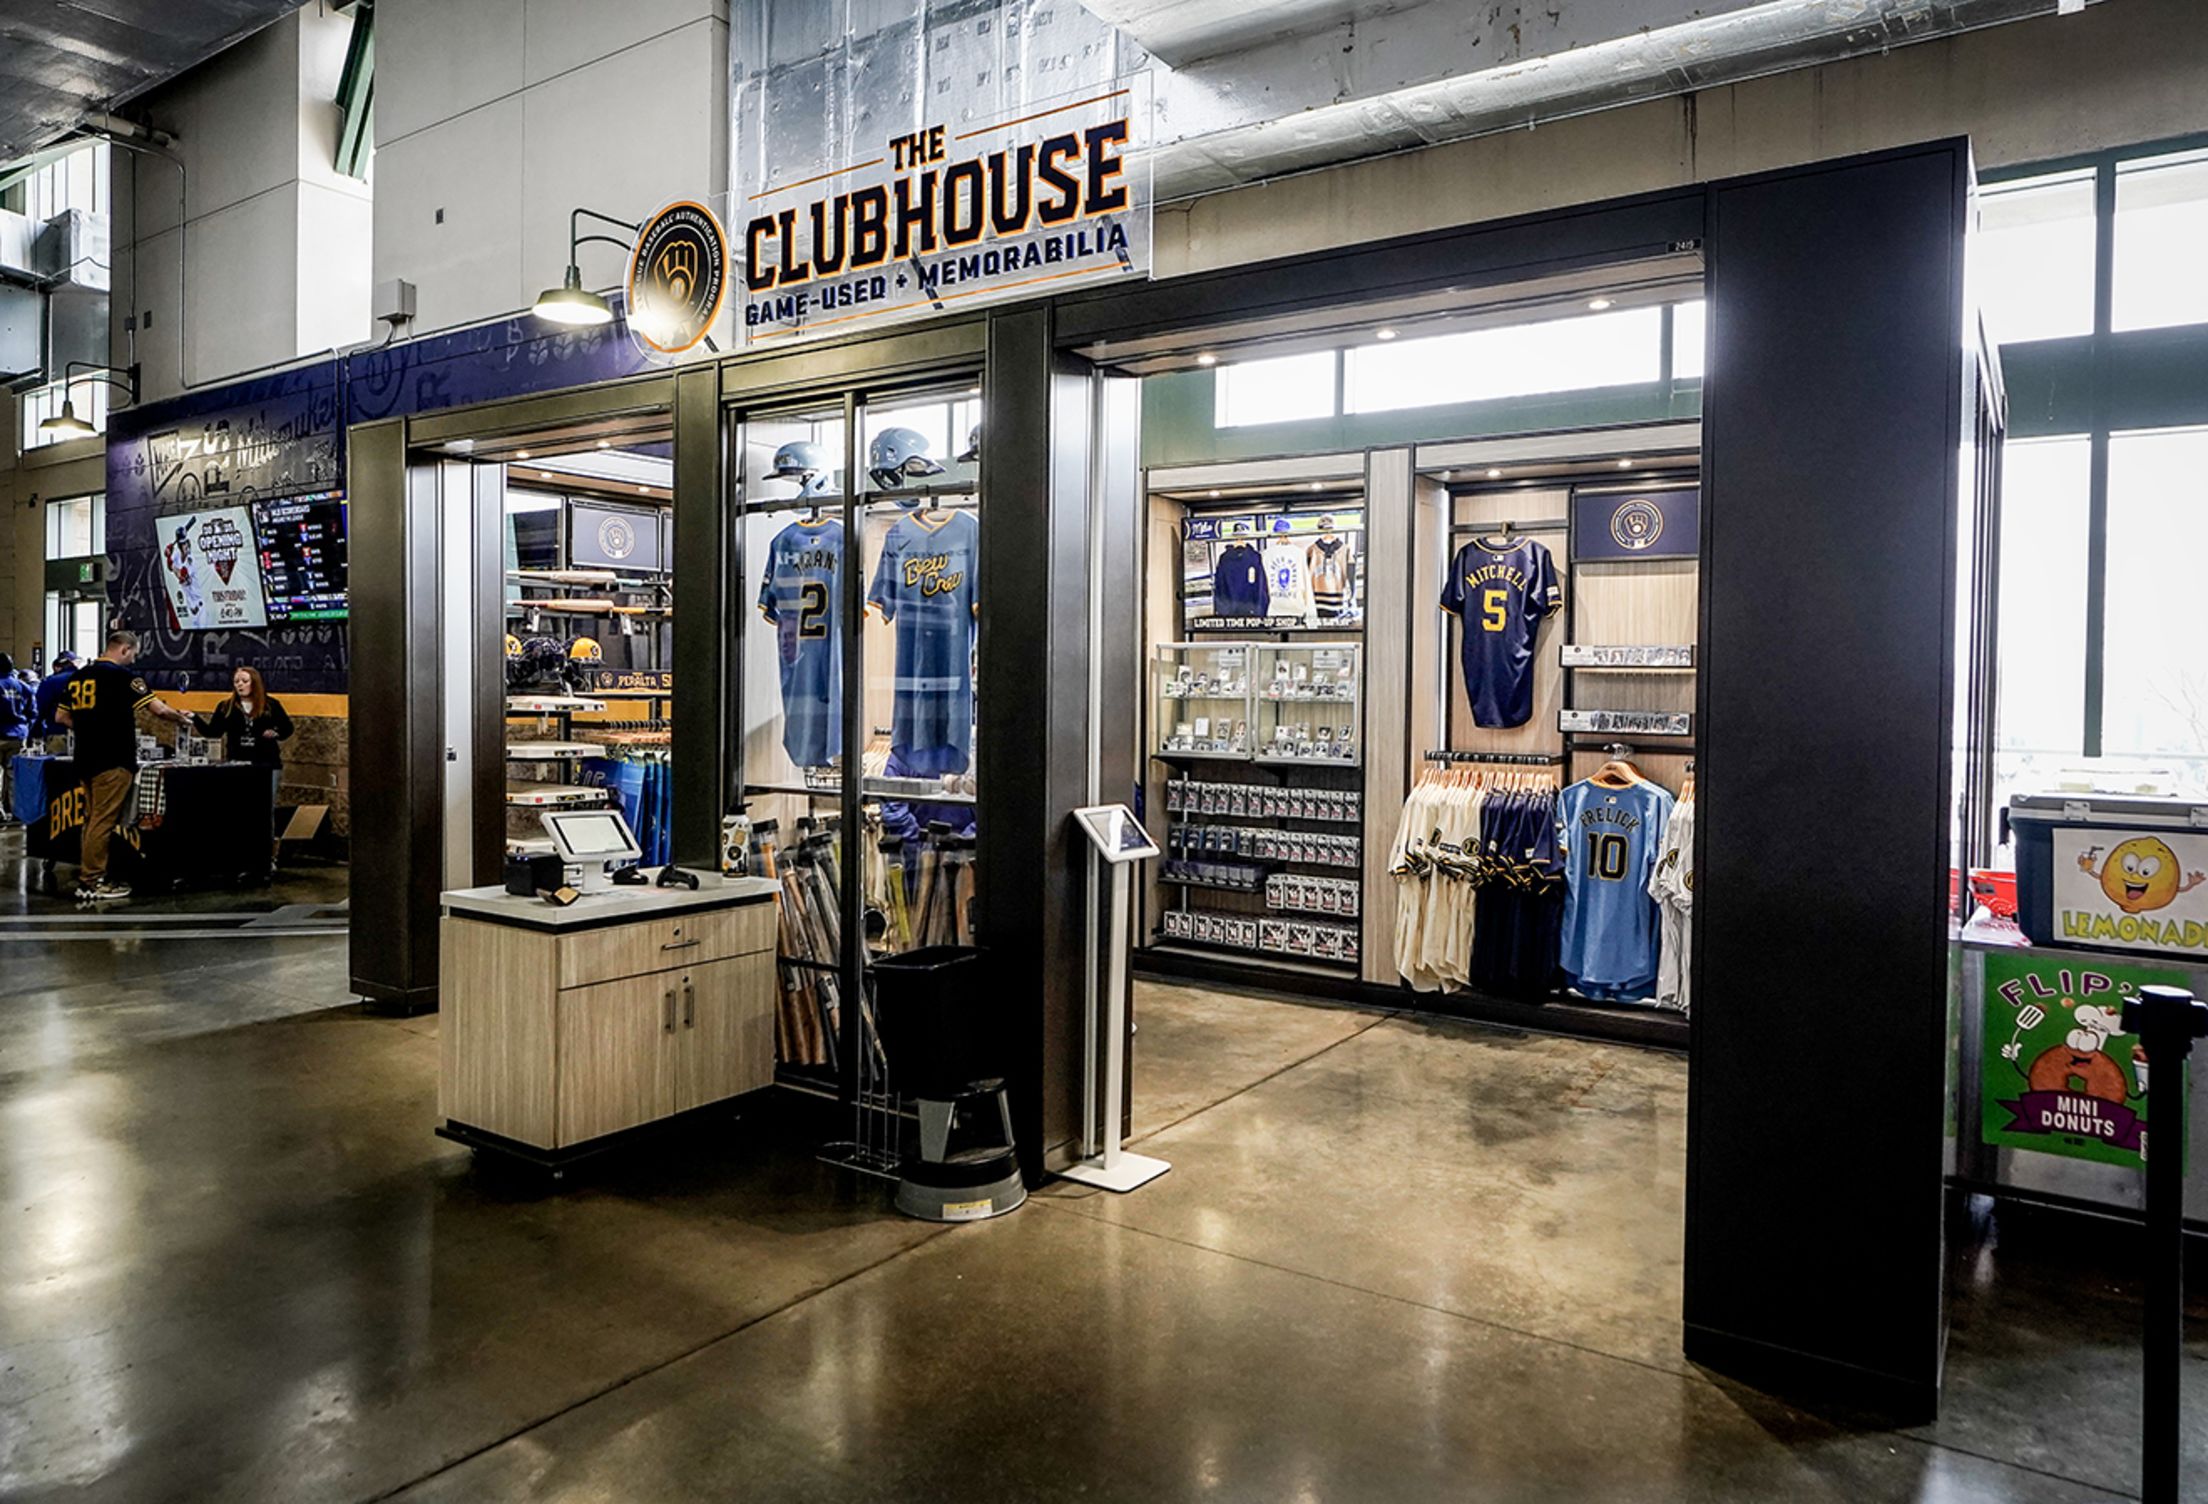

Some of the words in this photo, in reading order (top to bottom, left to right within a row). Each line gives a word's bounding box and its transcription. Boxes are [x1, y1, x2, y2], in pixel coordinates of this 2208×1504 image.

[889, 123, 946, 171] THE
[745, 117, 1130, 292] CLUBHOUSE
[675, 211, 720, 267] AUTHENTICATION
[744, 273, 886, 326] GAME-USED
[917, 223, 1129, 290] MEMORABILIA
[921, 571, 964, 598] Crew
[1465, 564, 1528, 592] MITCHELL
[800, 581, 829, 639] 2
[1482, 589, 1508, 632] 5
[67, 679, 96, 711] 38
[1579, 807, 1641, 833] FRELICK
[1587, 832, 1630, 881] 10
[2062, 910, 2208, 949] LEMONAD
[1997, 969, 2143, 1007] FLIP'
[2041, 1110, 2116, 1137] DONUTS
[2056, 1095, 2099, 1117] MINI
